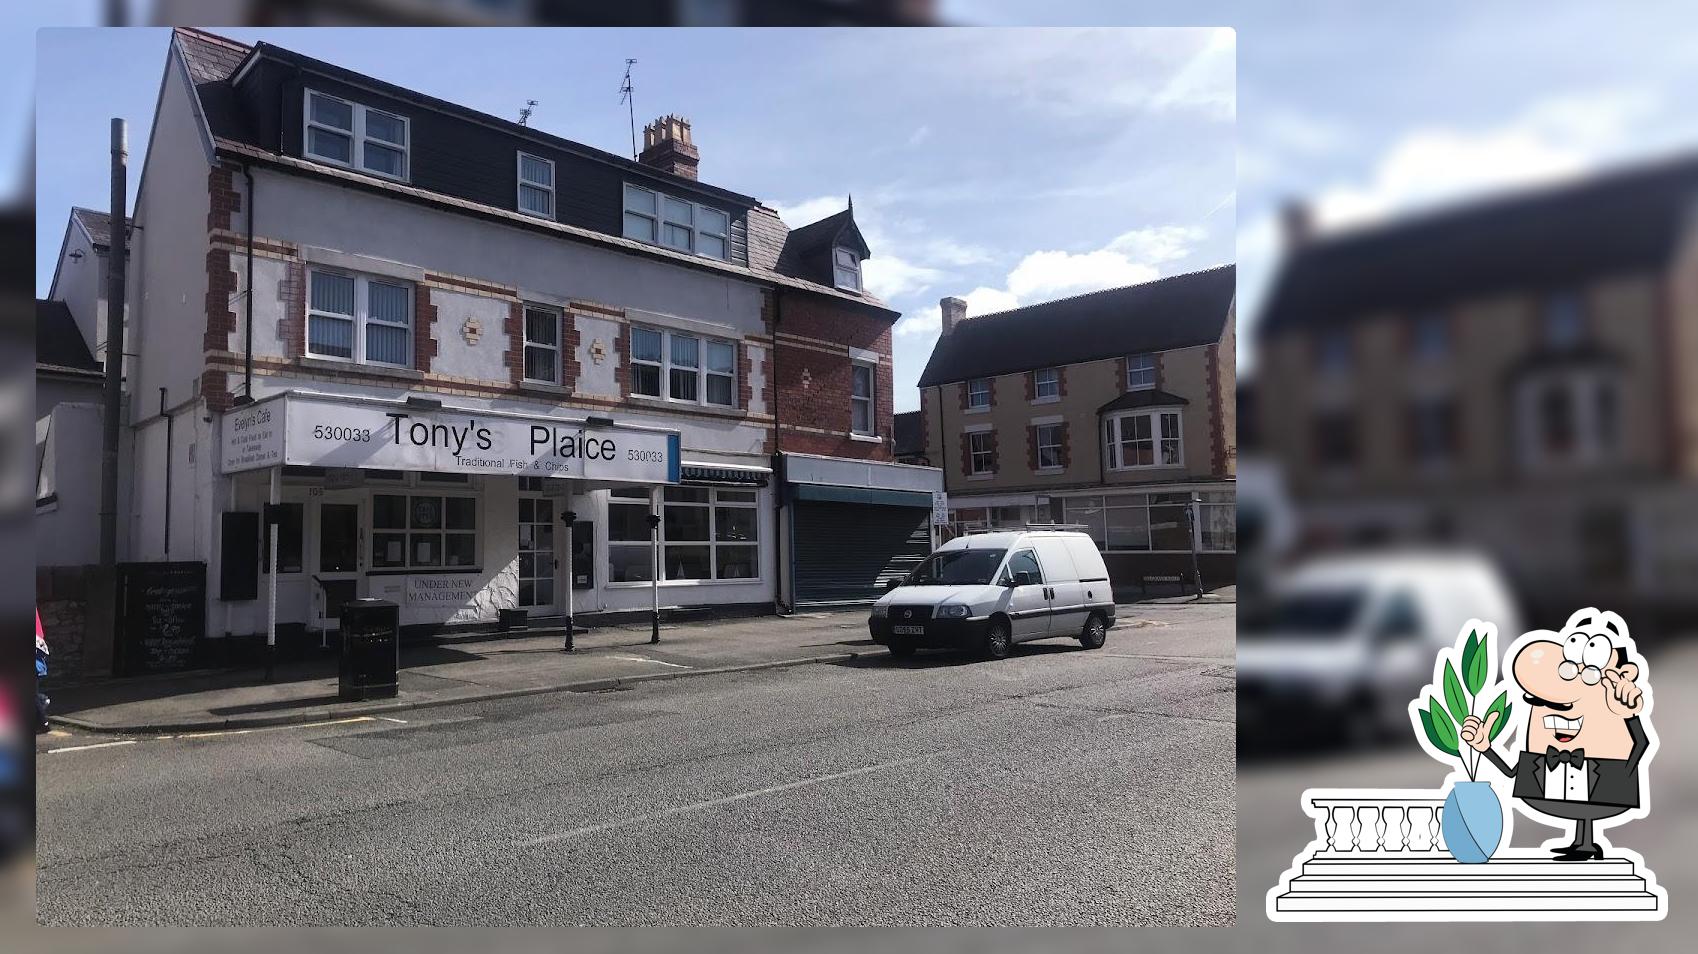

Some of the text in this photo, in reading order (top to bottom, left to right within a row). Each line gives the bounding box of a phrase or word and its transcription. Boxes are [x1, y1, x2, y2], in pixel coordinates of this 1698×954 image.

[257, 409, 271, 423] Cafe
[313, 412, 663, 463] 530033 Tony's Plaice 530033
[455, 456, 569, 472] Traditional Fish & Chips
[414, 578, 473, 589] UNDER NEW
